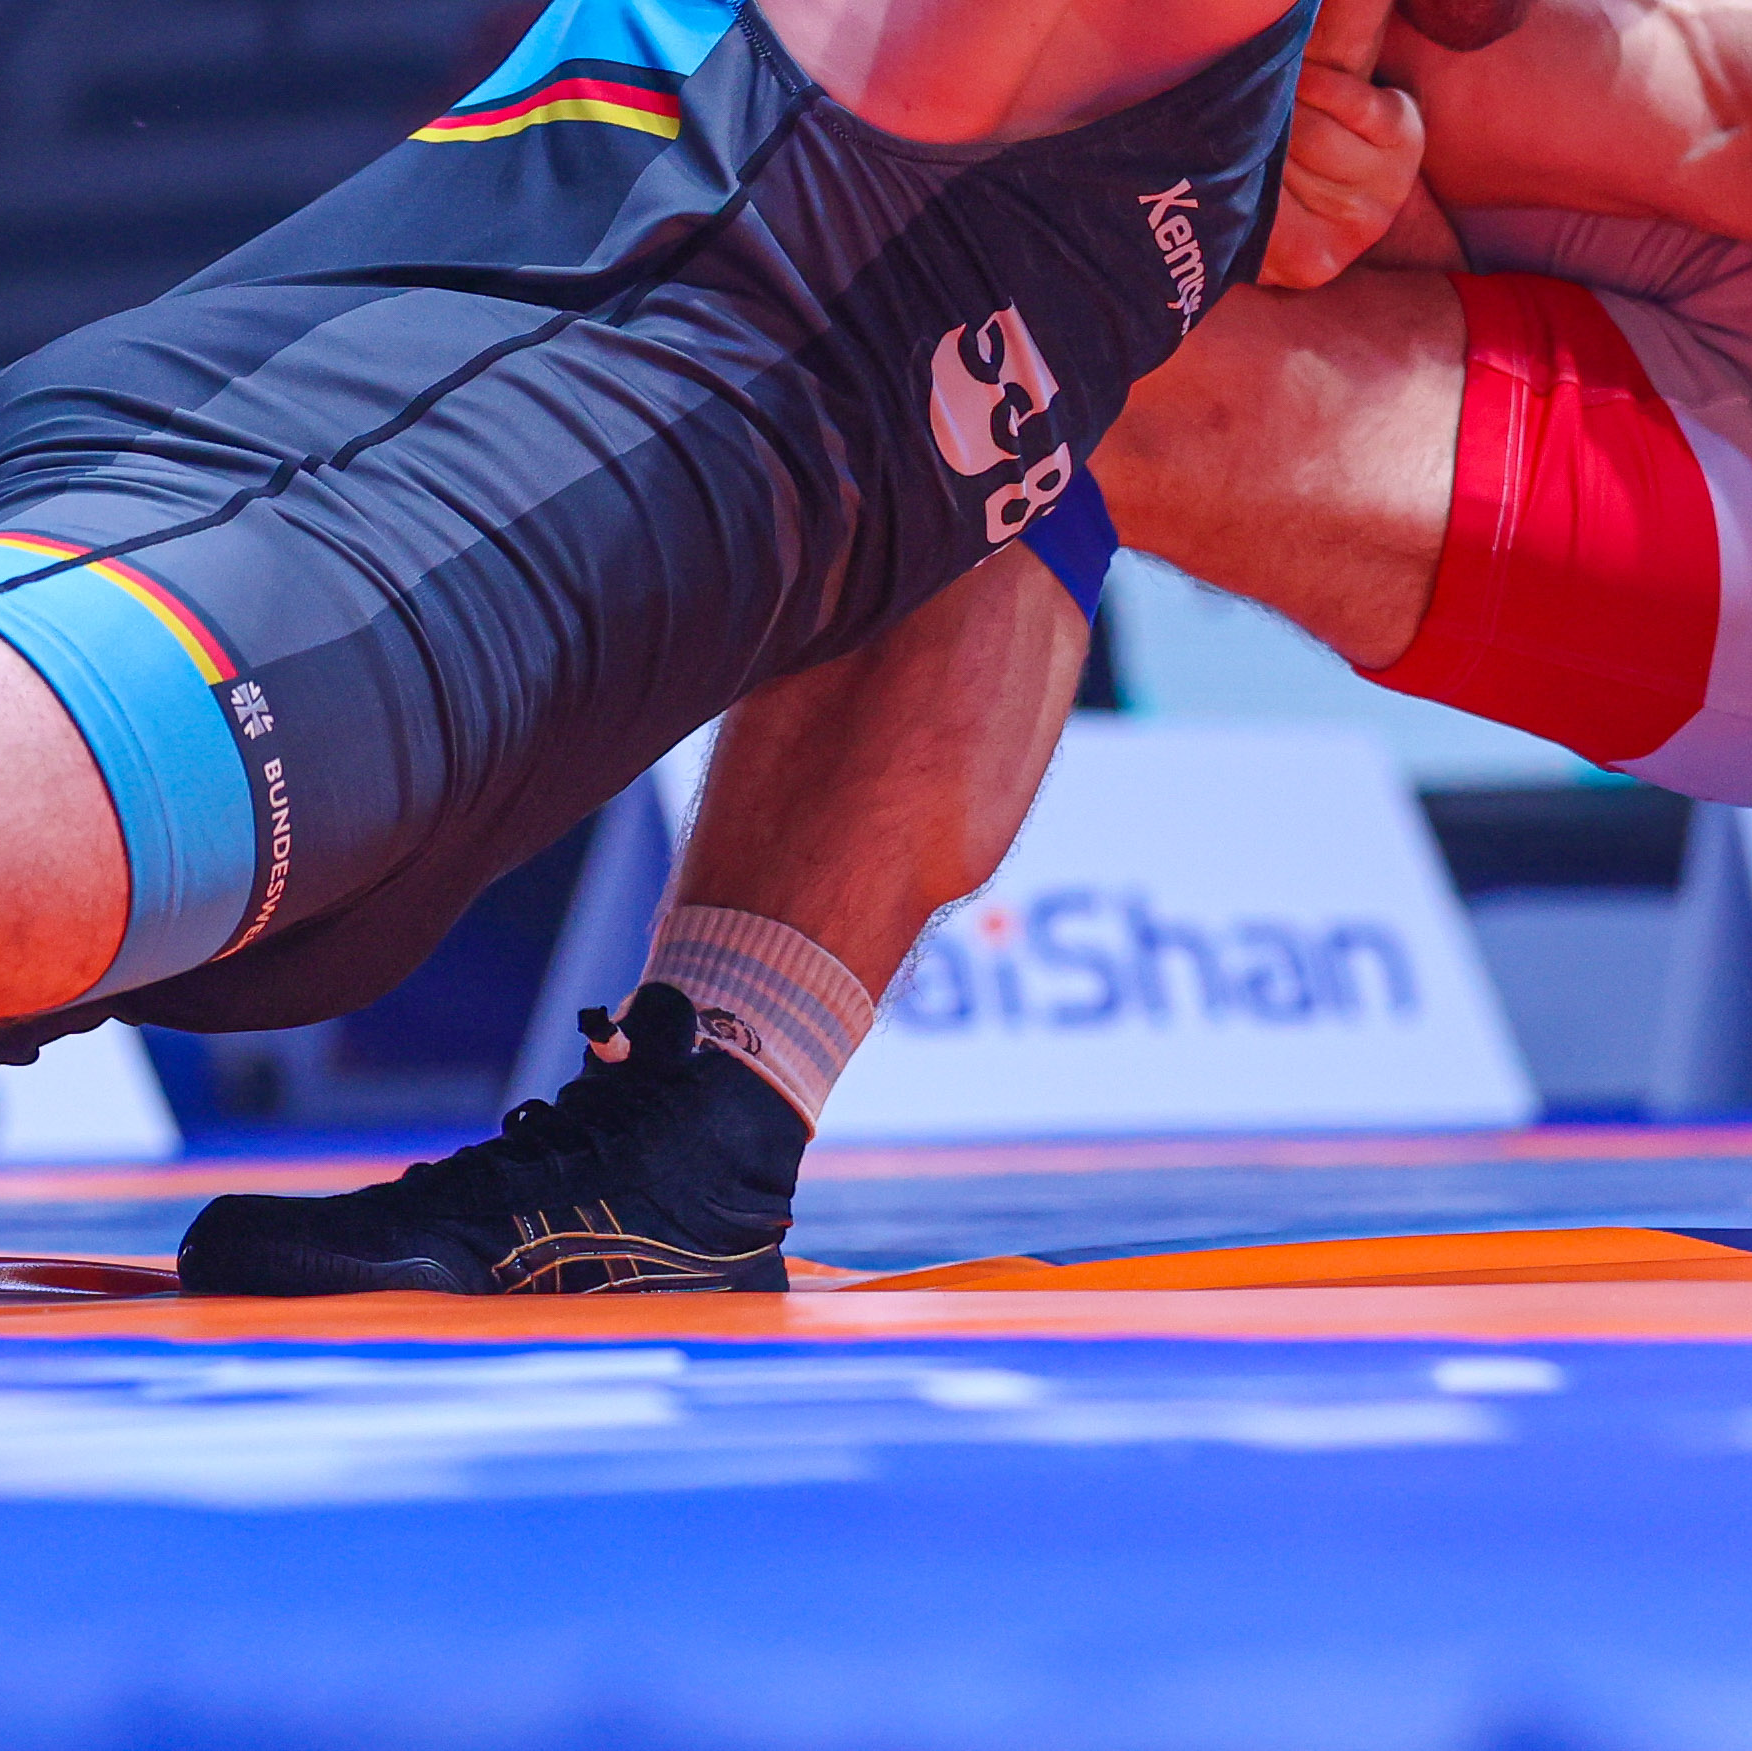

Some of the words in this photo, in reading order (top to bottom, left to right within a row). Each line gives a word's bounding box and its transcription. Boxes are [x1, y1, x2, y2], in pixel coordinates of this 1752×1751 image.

[1137, 177, 1205, 337] Kemp
[209, 756, 292, 962] BUNDESWE
[892, 886, 1423, 1036] aiShan
